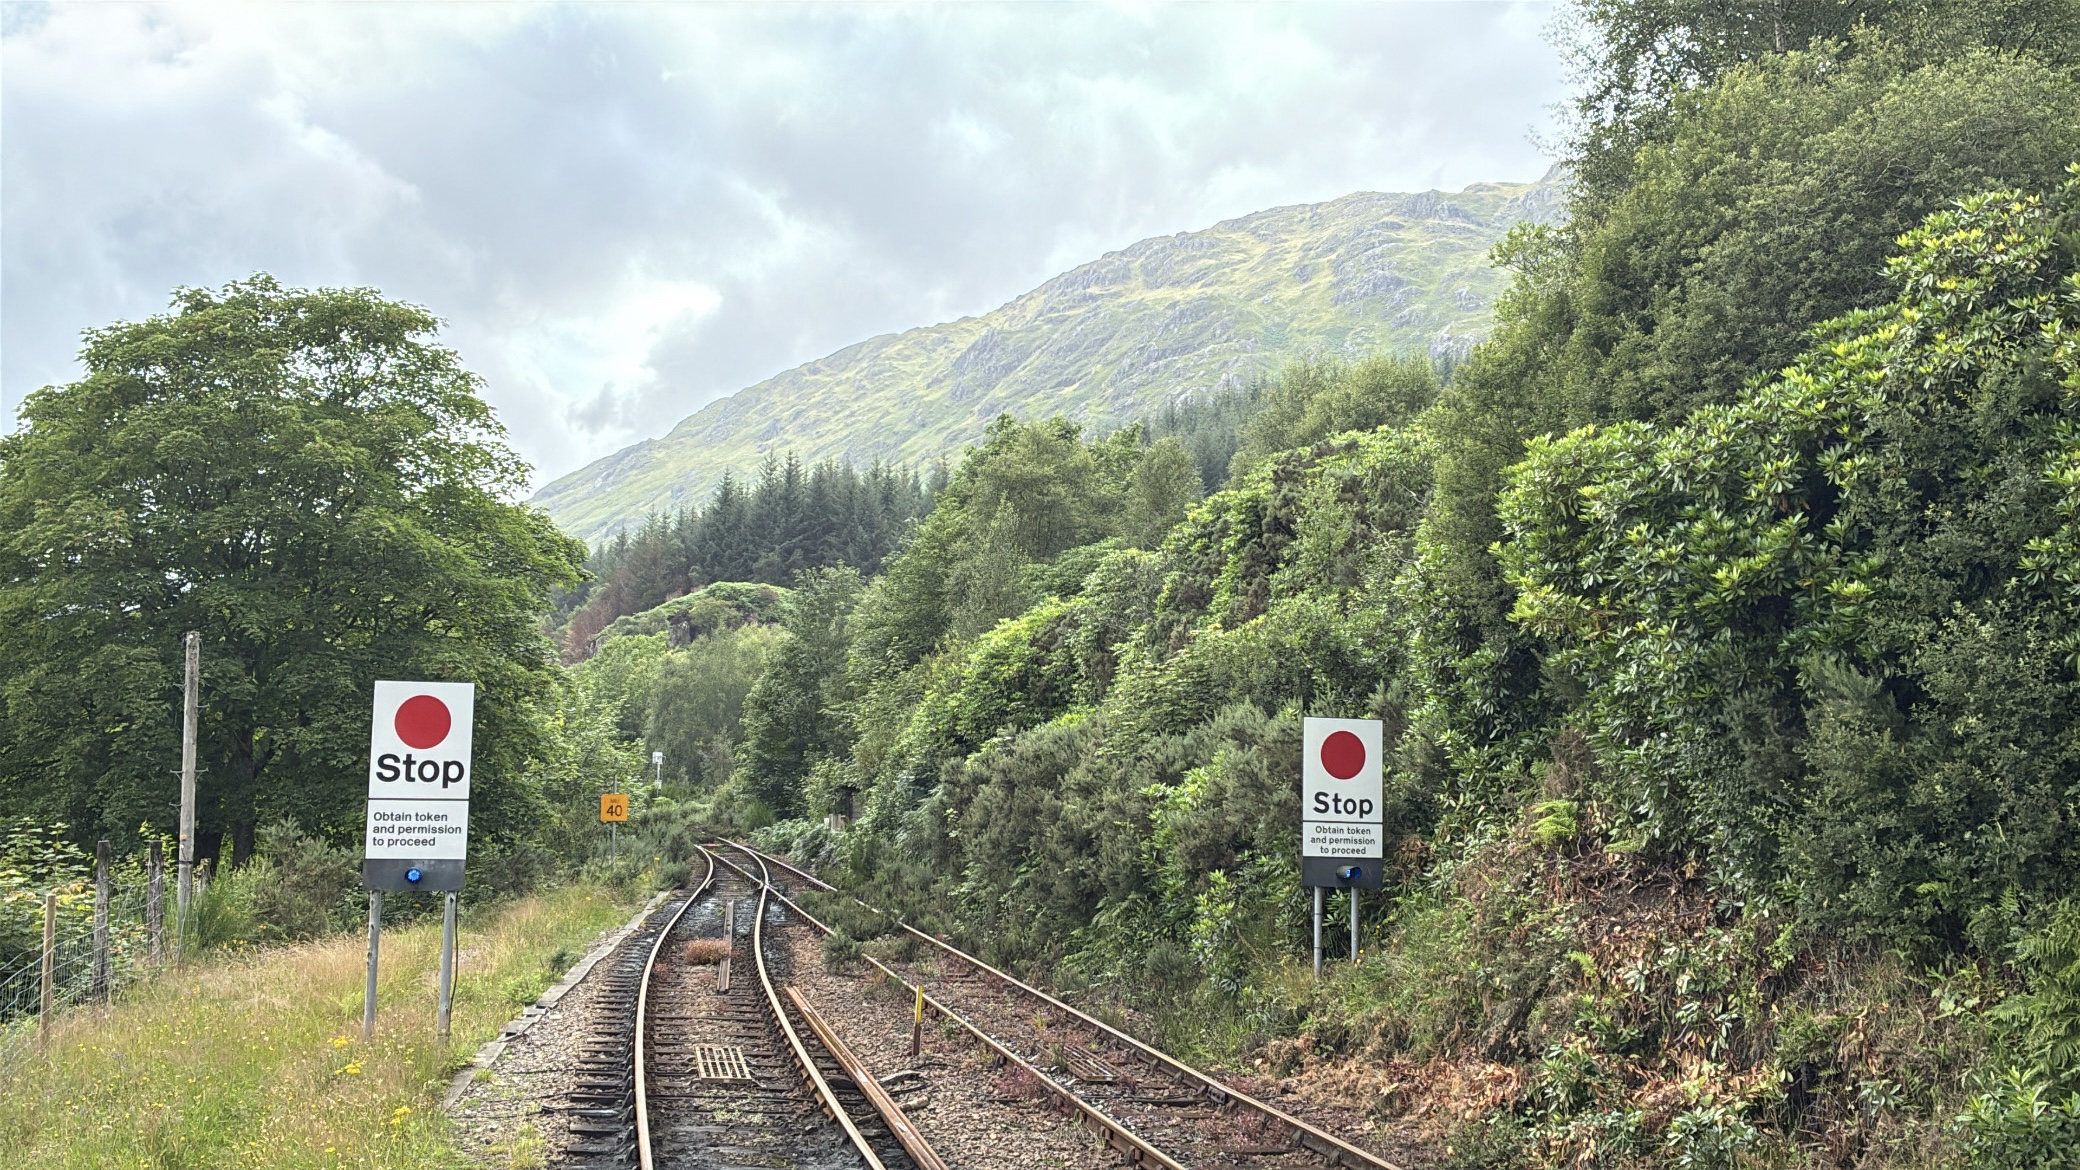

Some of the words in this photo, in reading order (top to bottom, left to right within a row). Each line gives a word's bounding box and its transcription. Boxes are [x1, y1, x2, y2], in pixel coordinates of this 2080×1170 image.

[376, 753, 464, 789] Stop
[1313, 791, 1373, 819] Stop
[606, 805, 622, 816] 40
[373, 812, 412, 822] Obtain
[415, 812, 448, 822] token
[373, 825, 395, 834] and
[397, 825, 462, 835] permission
[1315, 826, 1344, 834] Obtain
[1347, 827, 1371, 835] token
[372, 837, 384, 846] to
[387, 837, 436, 847] proceed
[1310, 836, 1327, 844] and
[1329, 837, 1376, 845] permission
[1320, 846, 1329, 854] to
[1332, 846, 1367, 855] proceed
